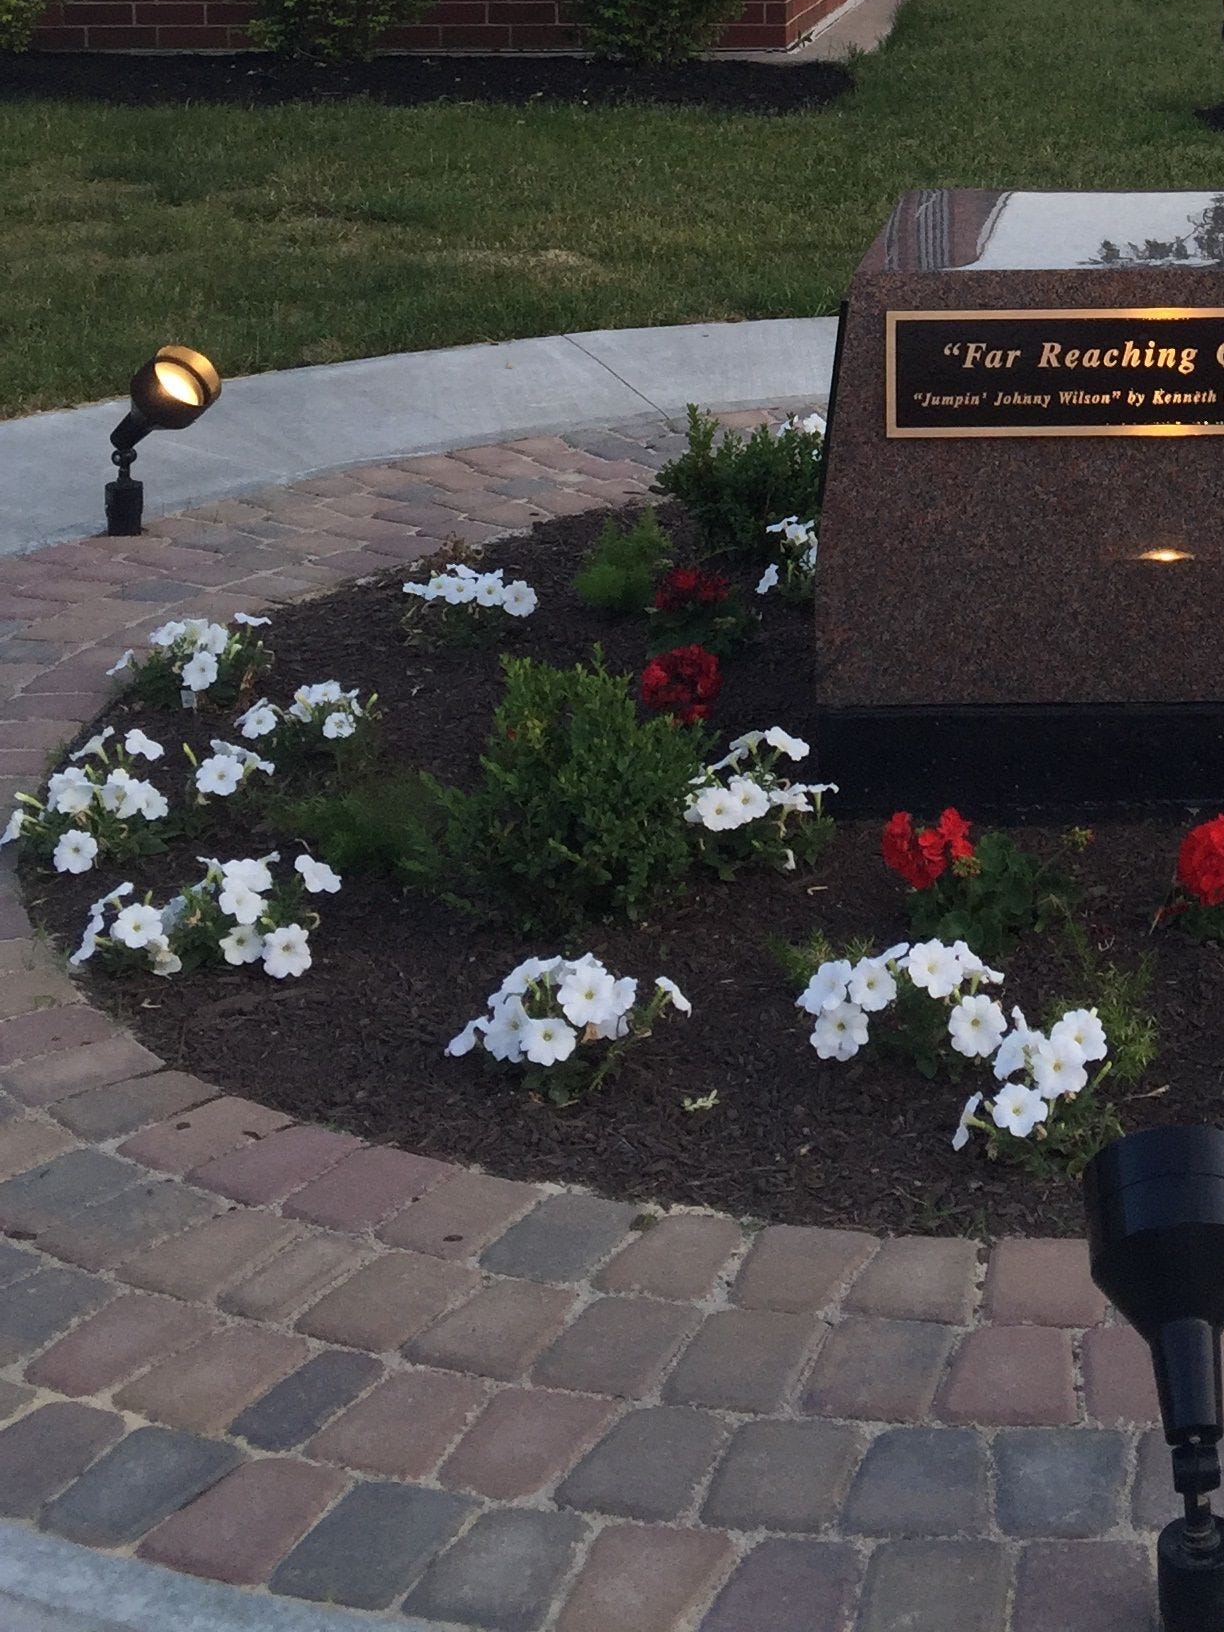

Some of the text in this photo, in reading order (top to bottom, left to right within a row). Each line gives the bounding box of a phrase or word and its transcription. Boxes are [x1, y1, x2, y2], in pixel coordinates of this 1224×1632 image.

[943, 342, 1022, 369] “Far
[1037, 340, 1199, 374] Reaching
[993, 391, 1051, 409] Johnny
[1060, 390, 1122, 405] Wilson”
[1126, 388, 1146, 408] by
[1152, 388, 1217, 405] Kenneth
